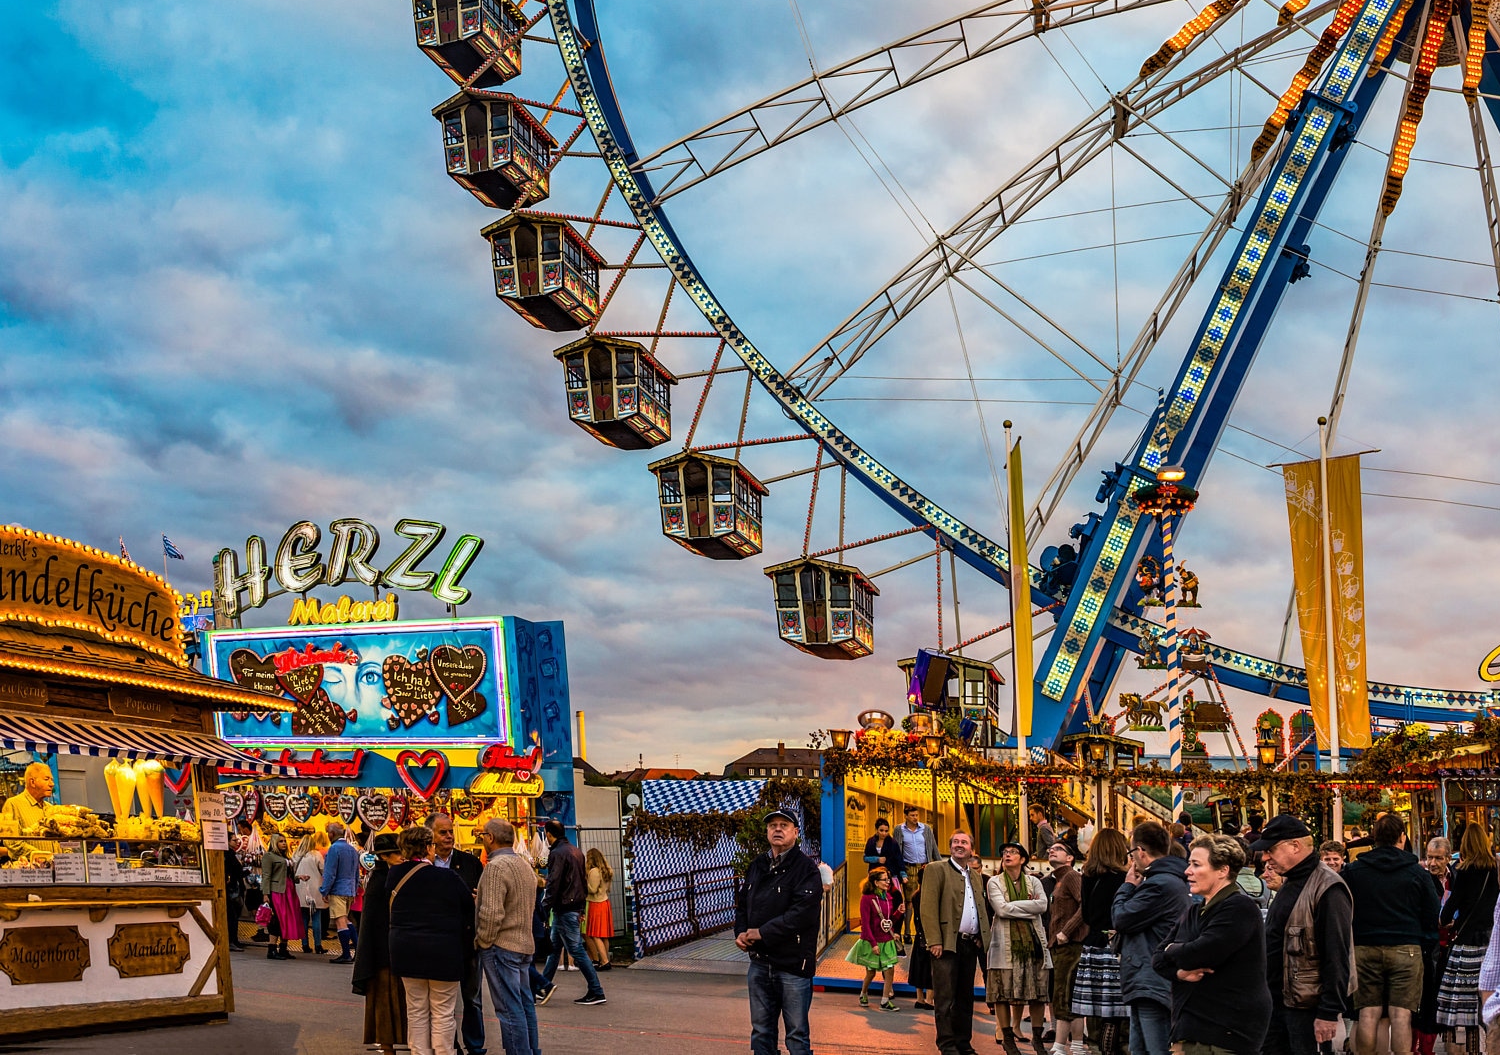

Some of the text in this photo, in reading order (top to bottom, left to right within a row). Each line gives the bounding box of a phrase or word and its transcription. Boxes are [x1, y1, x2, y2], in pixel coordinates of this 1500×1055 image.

[0, 555, 174, 641] ndelküche
[288, 593, 399, 625] Malerei
[393, 672, 431, 686] Ich hab
[1, 682, 47, 699] ewkerne
[405, 684, 427, 693] Dich
[414, 691, 433, 700] Lieb
[124, 696, 161, 713] Popcorn
[11, 943, 81, 969] Magenbrot
[124, 937, 177, 959] Mandeln
